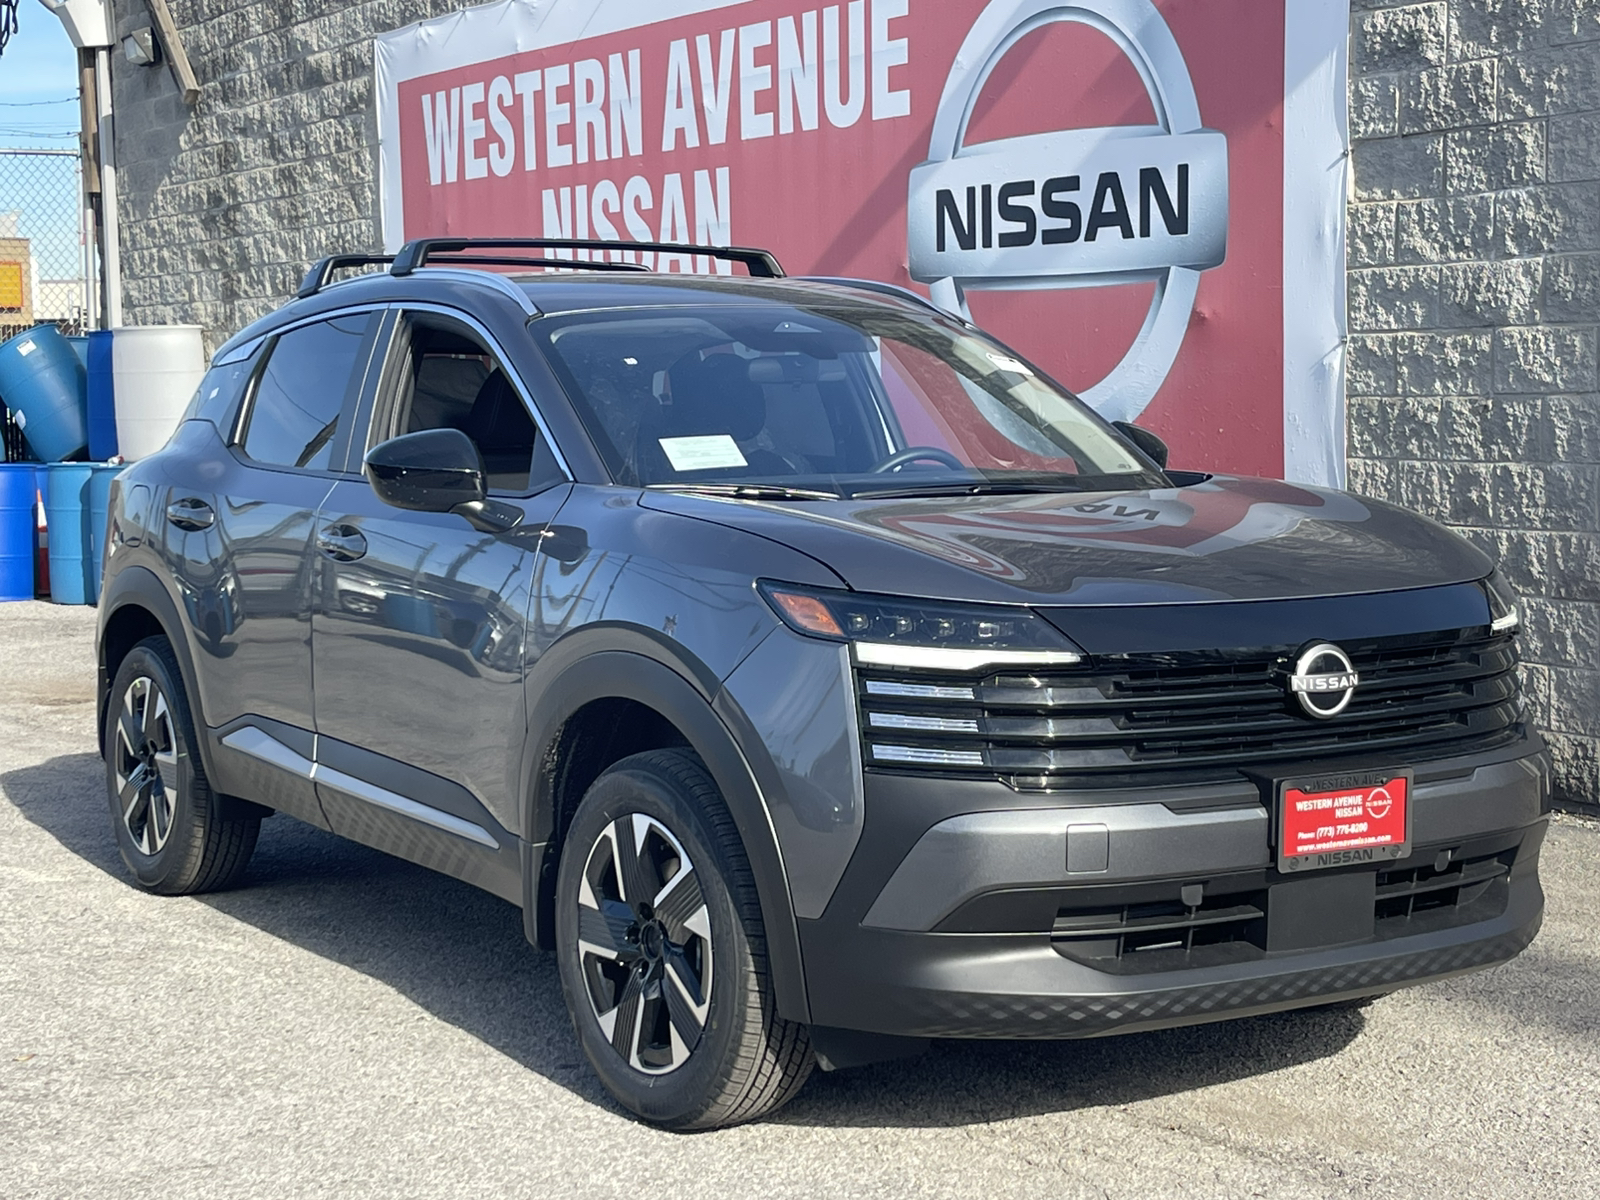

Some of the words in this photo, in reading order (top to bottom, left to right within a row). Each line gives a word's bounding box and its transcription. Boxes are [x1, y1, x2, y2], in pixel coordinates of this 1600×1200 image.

[421, 48, 643, 187] WESTERN
[660, 0, 911, 153] AVENUE
[935, 163, 1190, 252] NISSAN
[541, 166, 733, 276] NISSAN
[1294, 674, 1359, 690] NISSAN
[1312, 776, 1360, 791] WESTERN
[1296, 798, 1333, 812] WESTERN
[1333, 794, 1363, 808] AVENUE
[1365, 799, 1393, 808] NISSAN
[1335, 806, 1363, 818] NISSAN
[1316, 825, 1335, 840] (773)
[1317, 848, 1373, 866] NISSAN
